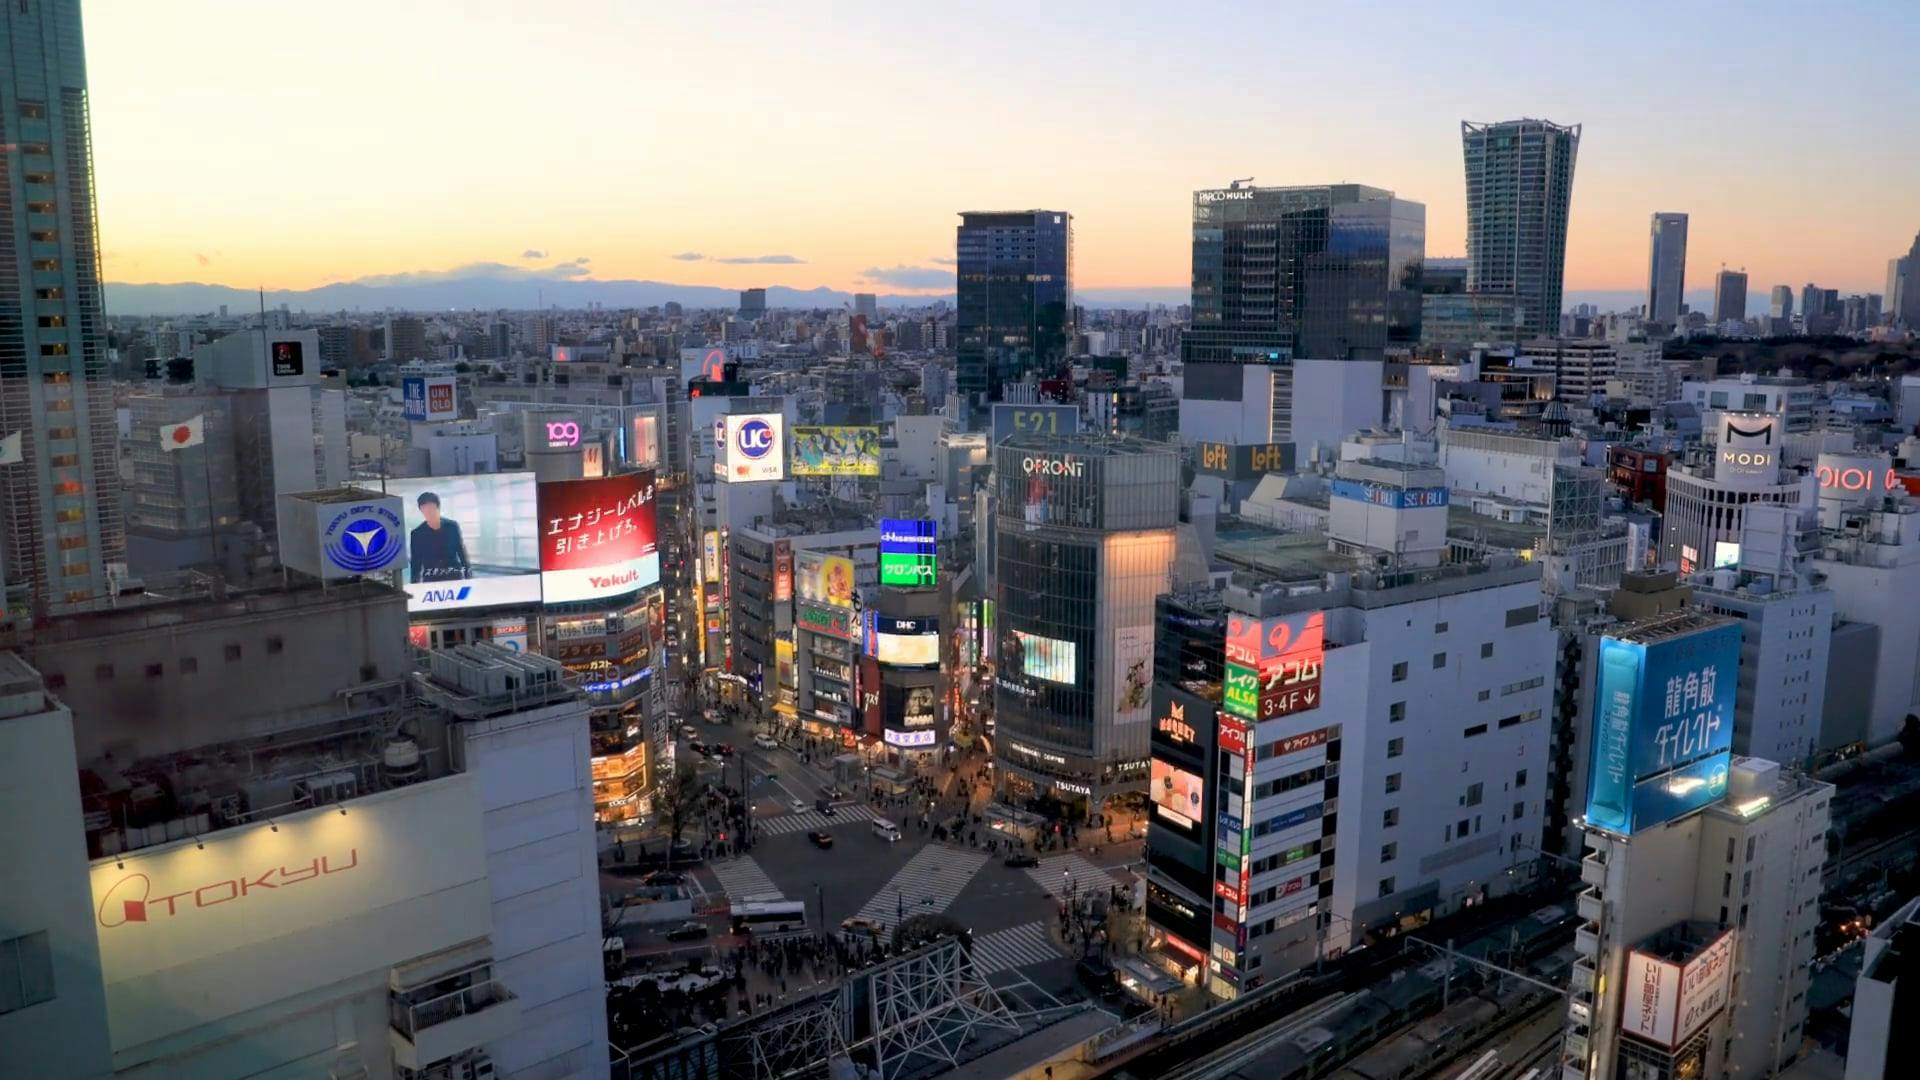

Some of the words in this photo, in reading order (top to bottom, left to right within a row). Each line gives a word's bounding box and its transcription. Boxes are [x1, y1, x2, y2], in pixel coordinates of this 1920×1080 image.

[1199, 191, 1225, 201] PARCO
[1226, 191, 1254, 200] HULIC
[408, 383, 421, 399] THE
[431, 388, 449, 398] UNI
[546, 421, 580, 447] 109
[741, 428, 773, 448] UC
[1023, 457, 1084, 478] QFRONT
[1723, 452, 1771, 466] MODI
[1404, 491, 1442, 507] SEIBU
[548, 485, 654, 535] エナジーレベルを
[588, 569, 640, 588] Yakult
[885, 564, 934, 576] サロンパス
[422, 589, 456, 603] ANA
[896, 620, 916, 629] DHC
[590, 660, 613, 670] ガスト
[1228, 669, 1258, 690] レイク
[1265, 659, 1318, 691] アコム
[1228, 686, 1257, 706] ALSA
[1665, 665, 1717, 719] 龍角散
[1655, 710, 1721, 765] ダイレクト
[1118, 759, 1151, 772] TSUTAY
[1055, 781, 1091, 795] TSUTAYA
[148, 848, 357, 917] TOKYU
